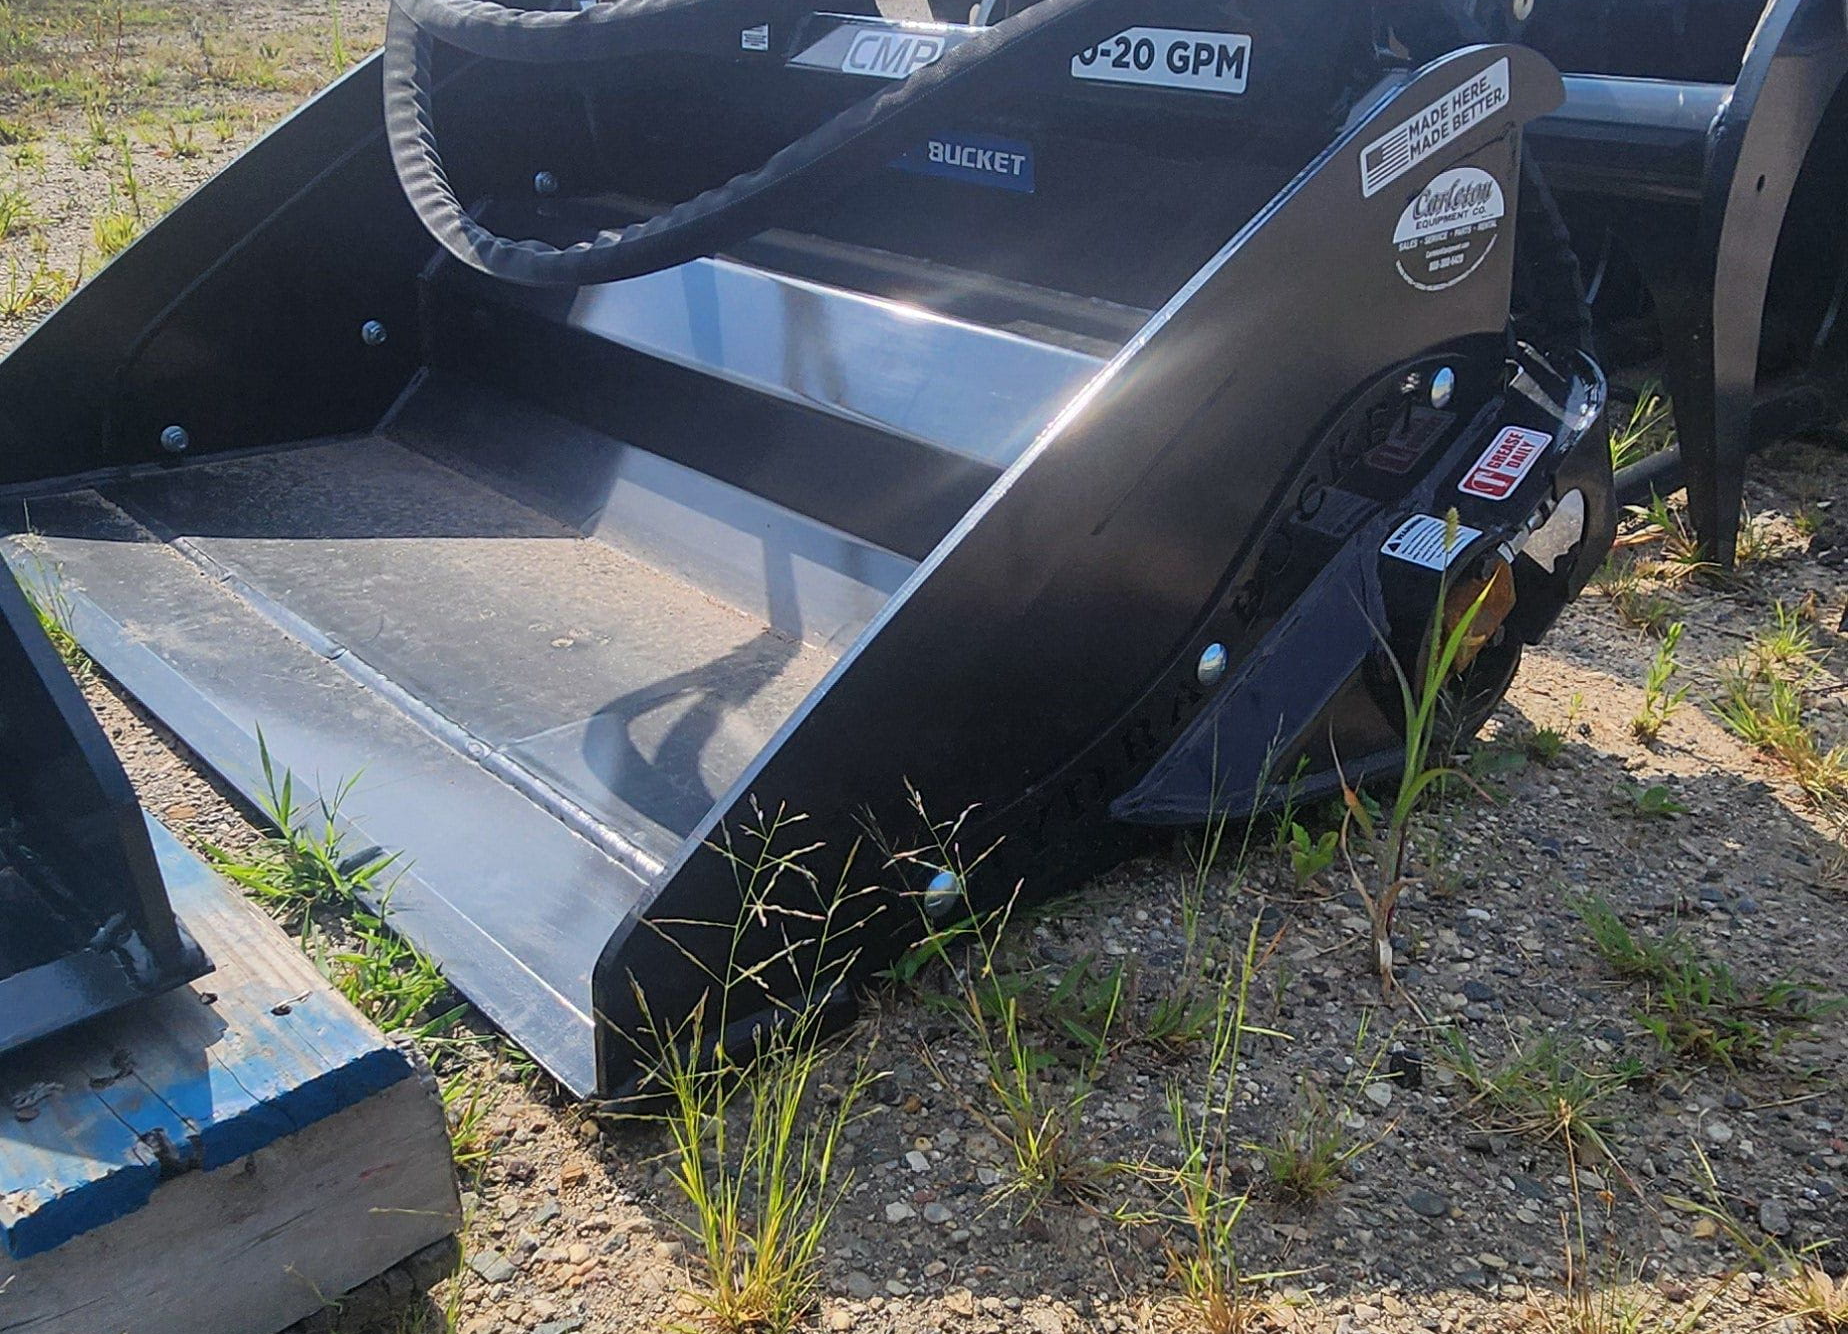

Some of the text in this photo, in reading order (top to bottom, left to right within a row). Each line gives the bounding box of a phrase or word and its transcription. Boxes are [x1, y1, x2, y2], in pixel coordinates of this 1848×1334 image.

[848, 34, 939, 74] CMP
[1166, 40, 1247, 80] GPM
[1408, 75, 1492, 141] MADE HERE.
[1409, 87, 1506, 161] MADE BETTER.
[928, 140, 1026, 176] BUCKET
[1412, 177, 1494, 221] Carleton
[1415, 210, 1469, 230] EQUIPMENT
[1486, 432, 1525, 469] GREASE
[1505, 440, 1536, 469] DAILY
